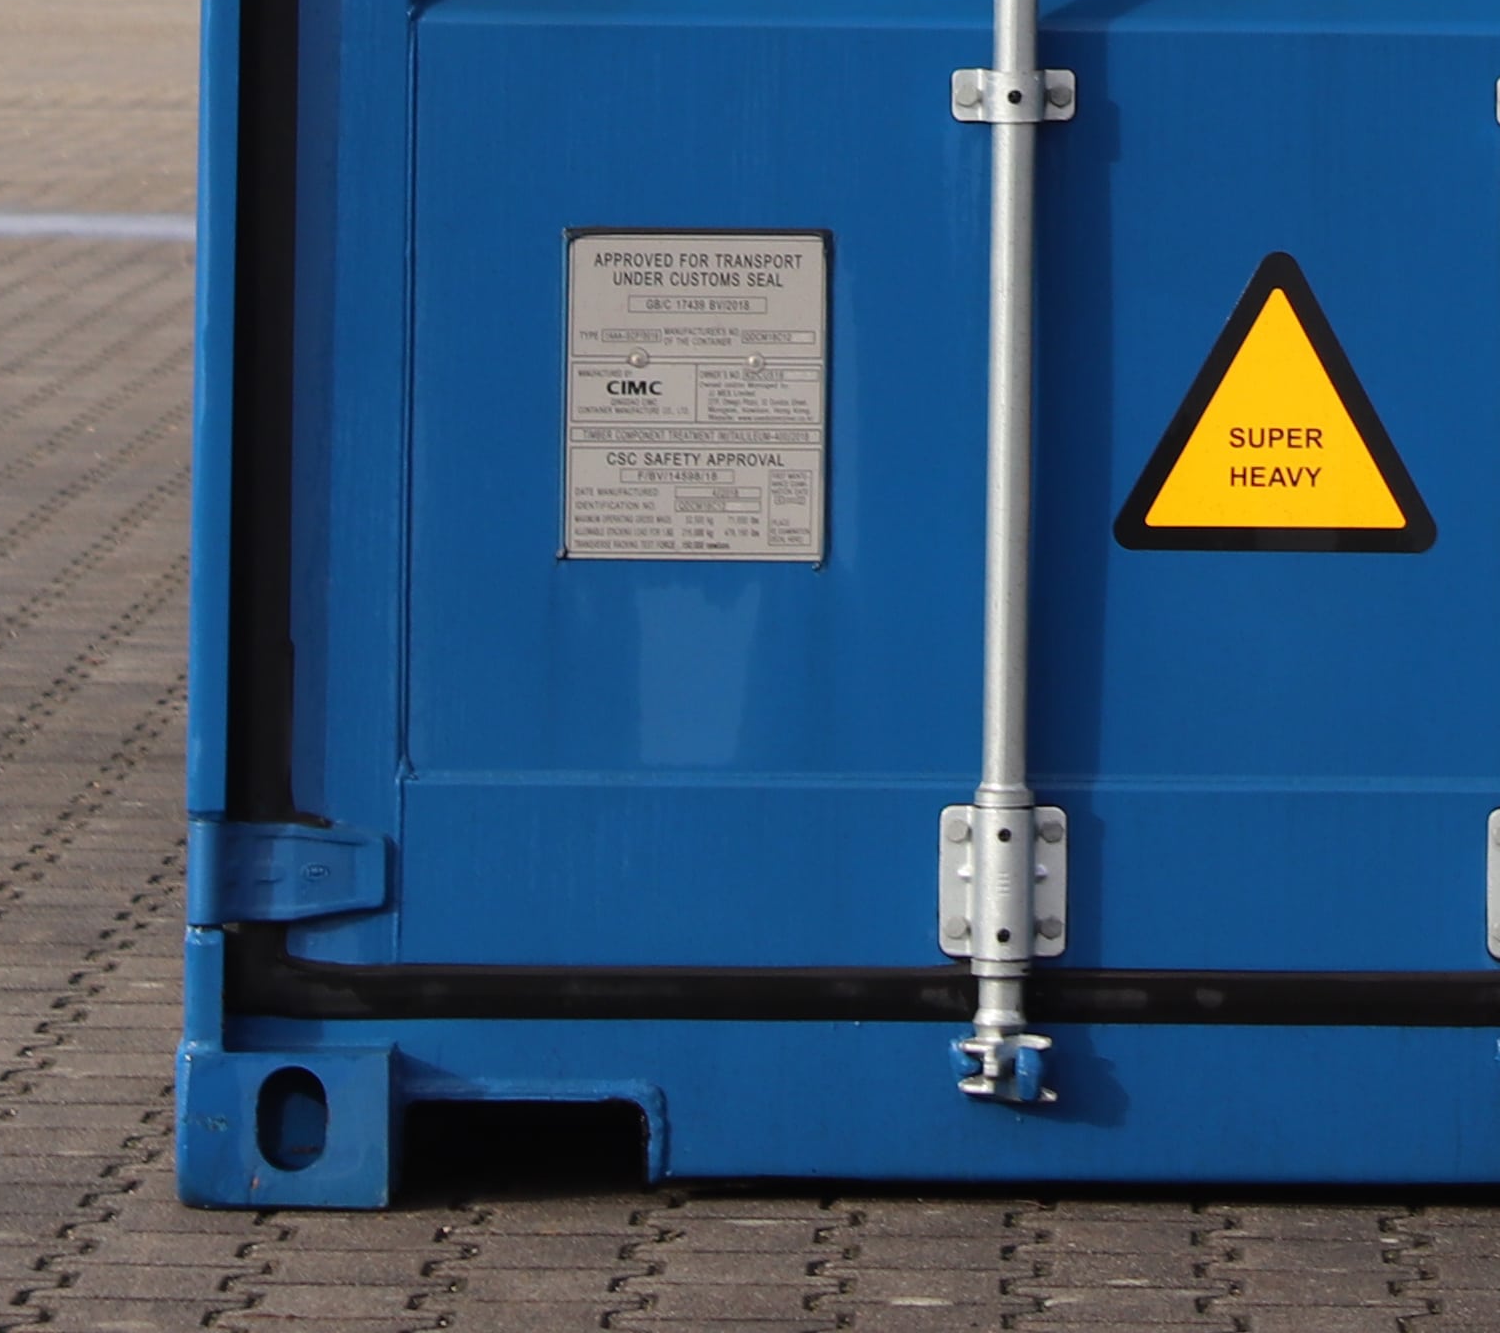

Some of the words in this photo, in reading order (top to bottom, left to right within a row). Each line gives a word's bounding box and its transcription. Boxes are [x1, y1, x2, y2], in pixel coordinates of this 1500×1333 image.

[594, 252, 674, 268] APPROVED
[679, 253, 709, 269] FOR
[715, 253, 803, 269] TRANSPORT
[613, 271, 664, 286] UNDER
[669, 271, 741, 287] CUSTOMS
[746, 272, 783, 288] SEAL
[606, 380, 661, 396] CIMC
[1229, 427, 1323, 449] SUPER
[606, 451, 637, 466] CSC
[643, 452, 701, 467] SAFETY
[706, 452, 785, 467] APPROVAL
[1230, 466, 1321, 487] HEAVY
